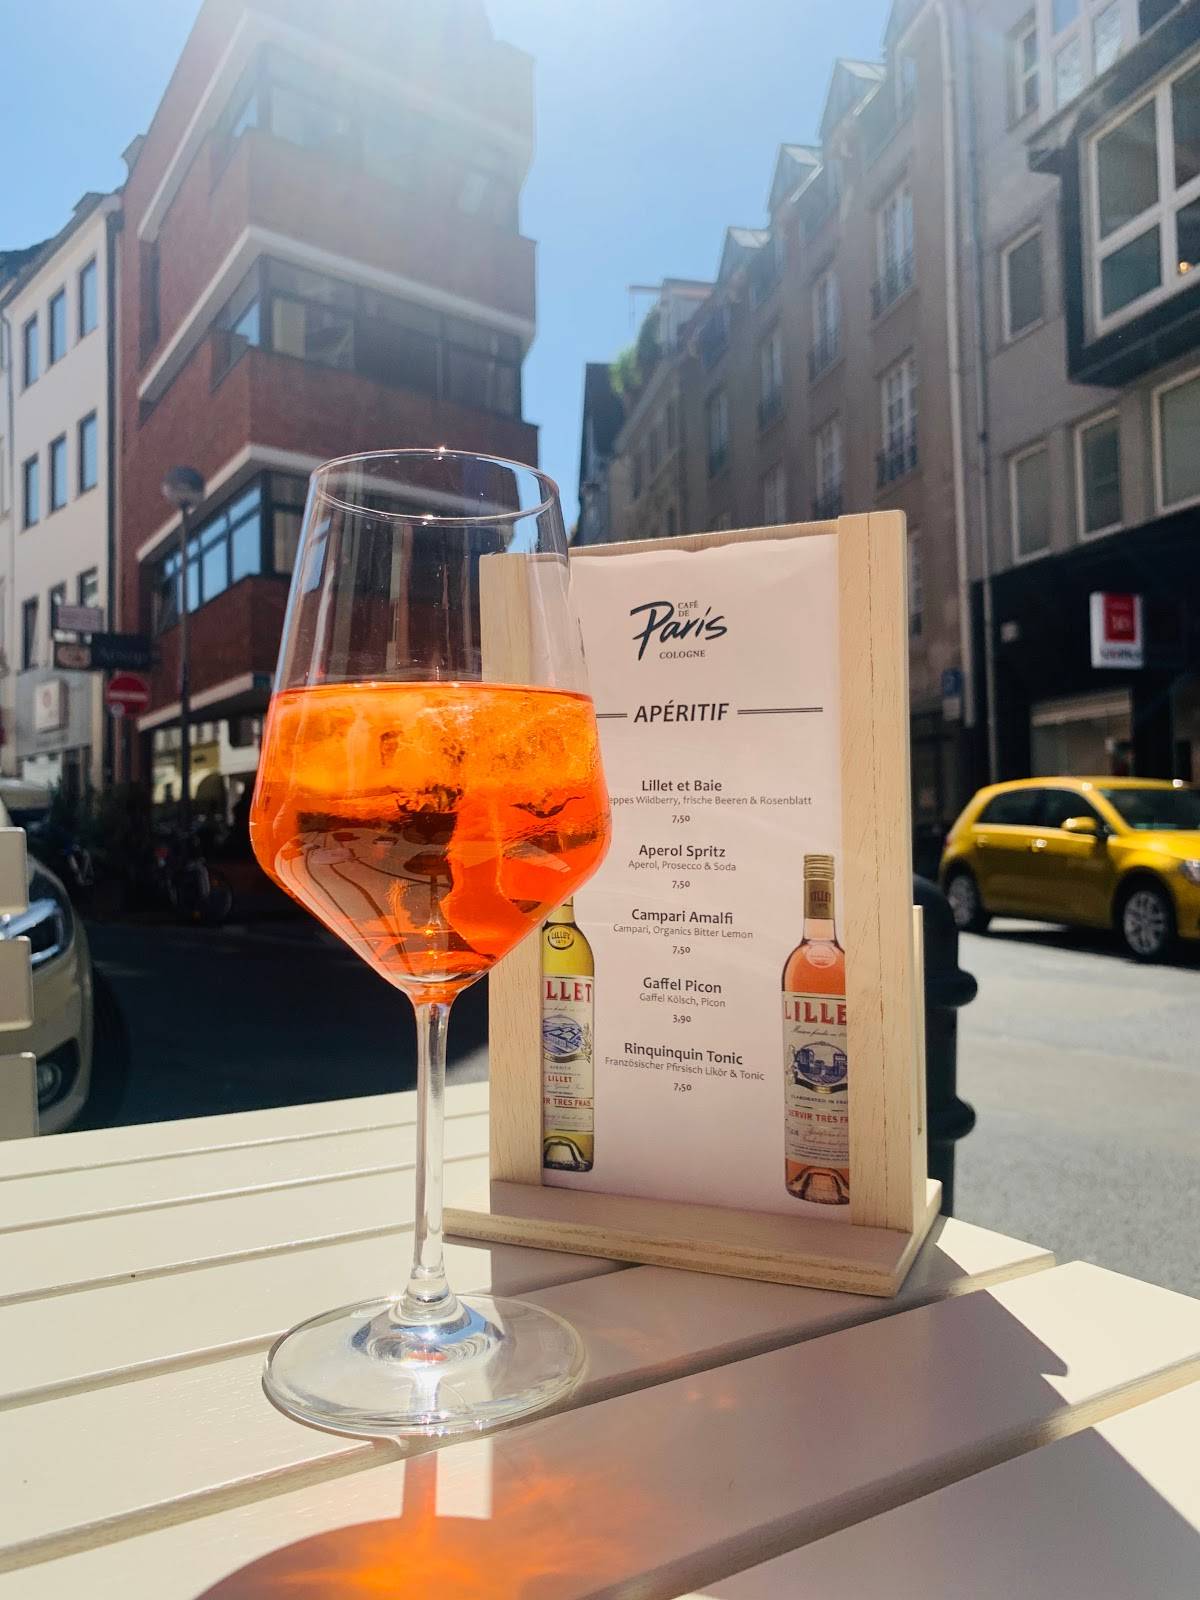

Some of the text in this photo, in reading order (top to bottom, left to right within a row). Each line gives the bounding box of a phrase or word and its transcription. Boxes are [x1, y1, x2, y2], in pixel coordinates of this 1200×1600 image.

[678, 600, 699, 609] CAFÉ
[630, 600, 728, 661] Paris
[660, 650, 706, 660] COLOGNE
[634, 700, 730, 723] APÉRITIF
[642, 779, 722, 792] Lillet et Baie
[636, 795, 681, 807] Wildberry,
[683, 795, 713, 805] frische
[715, 796, 748, 805] Beeren
[750, 796, 757, 805] &
[760, 795, 812, 806] Rosenblatt
[672, 814, 691, 824] 7,50
[639, 844, 726, 860] Aperol Spritz
[628, 860, 736, 871] Aperol, Prosecco & Soda
[672, 880, 691, 889] 7,50
[632, 908, 733, 924] Campari Amalfi
[613, 924, 753, 939] Campari, Organics Bitter Lemon
[672, 946, 691, 955] 7,50
[643, 977, 722, 994] Gaffel Picon
[640, 993, 726, 1007] Gaffel Kölsch, Picon
[673, 1014, 692, 1024] 3,90
[624, 1042, 743, 1065] Rinquinquin Tonic
[606, 1056, 766, 1081] Französischer Pfirsisch Likör & Tonic
[674, 1083, 692, 1092] 7,50
